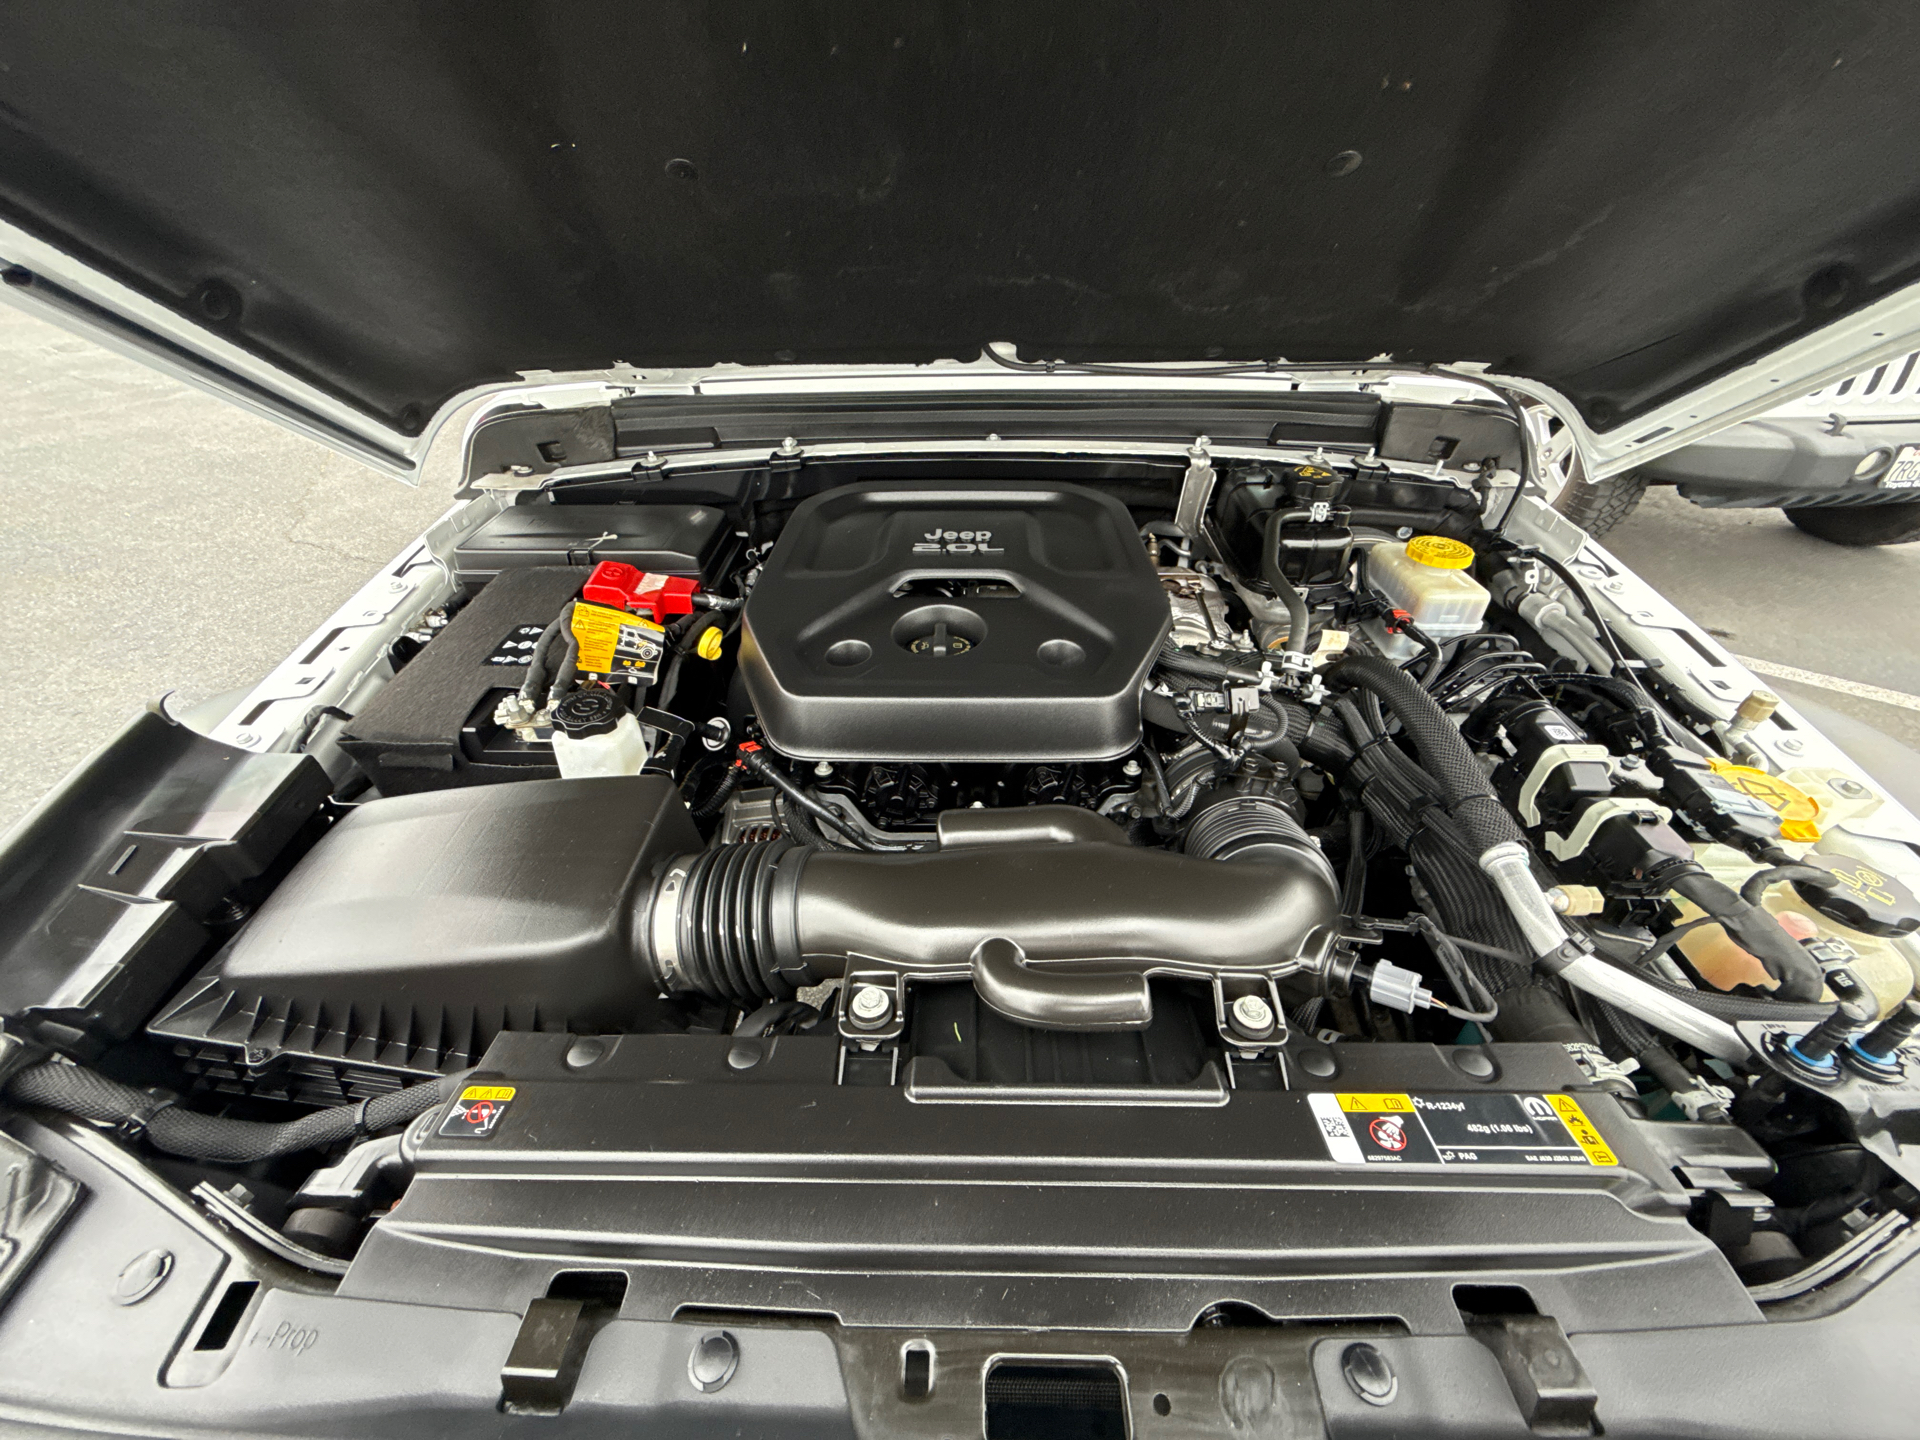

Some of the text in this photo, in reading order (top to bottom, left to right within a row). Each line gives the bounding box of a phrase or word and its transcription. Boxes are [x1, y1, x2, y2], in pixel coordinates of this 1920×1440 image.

[1888, 460, 1920, 480] 7RG
[924, 528, 992, 541] Jeep
[912, 543, 1004, 553] 2.0L
[1458, 1152, 1478, 1160] PAG
[267, 1320, 318, 1357] Prop
